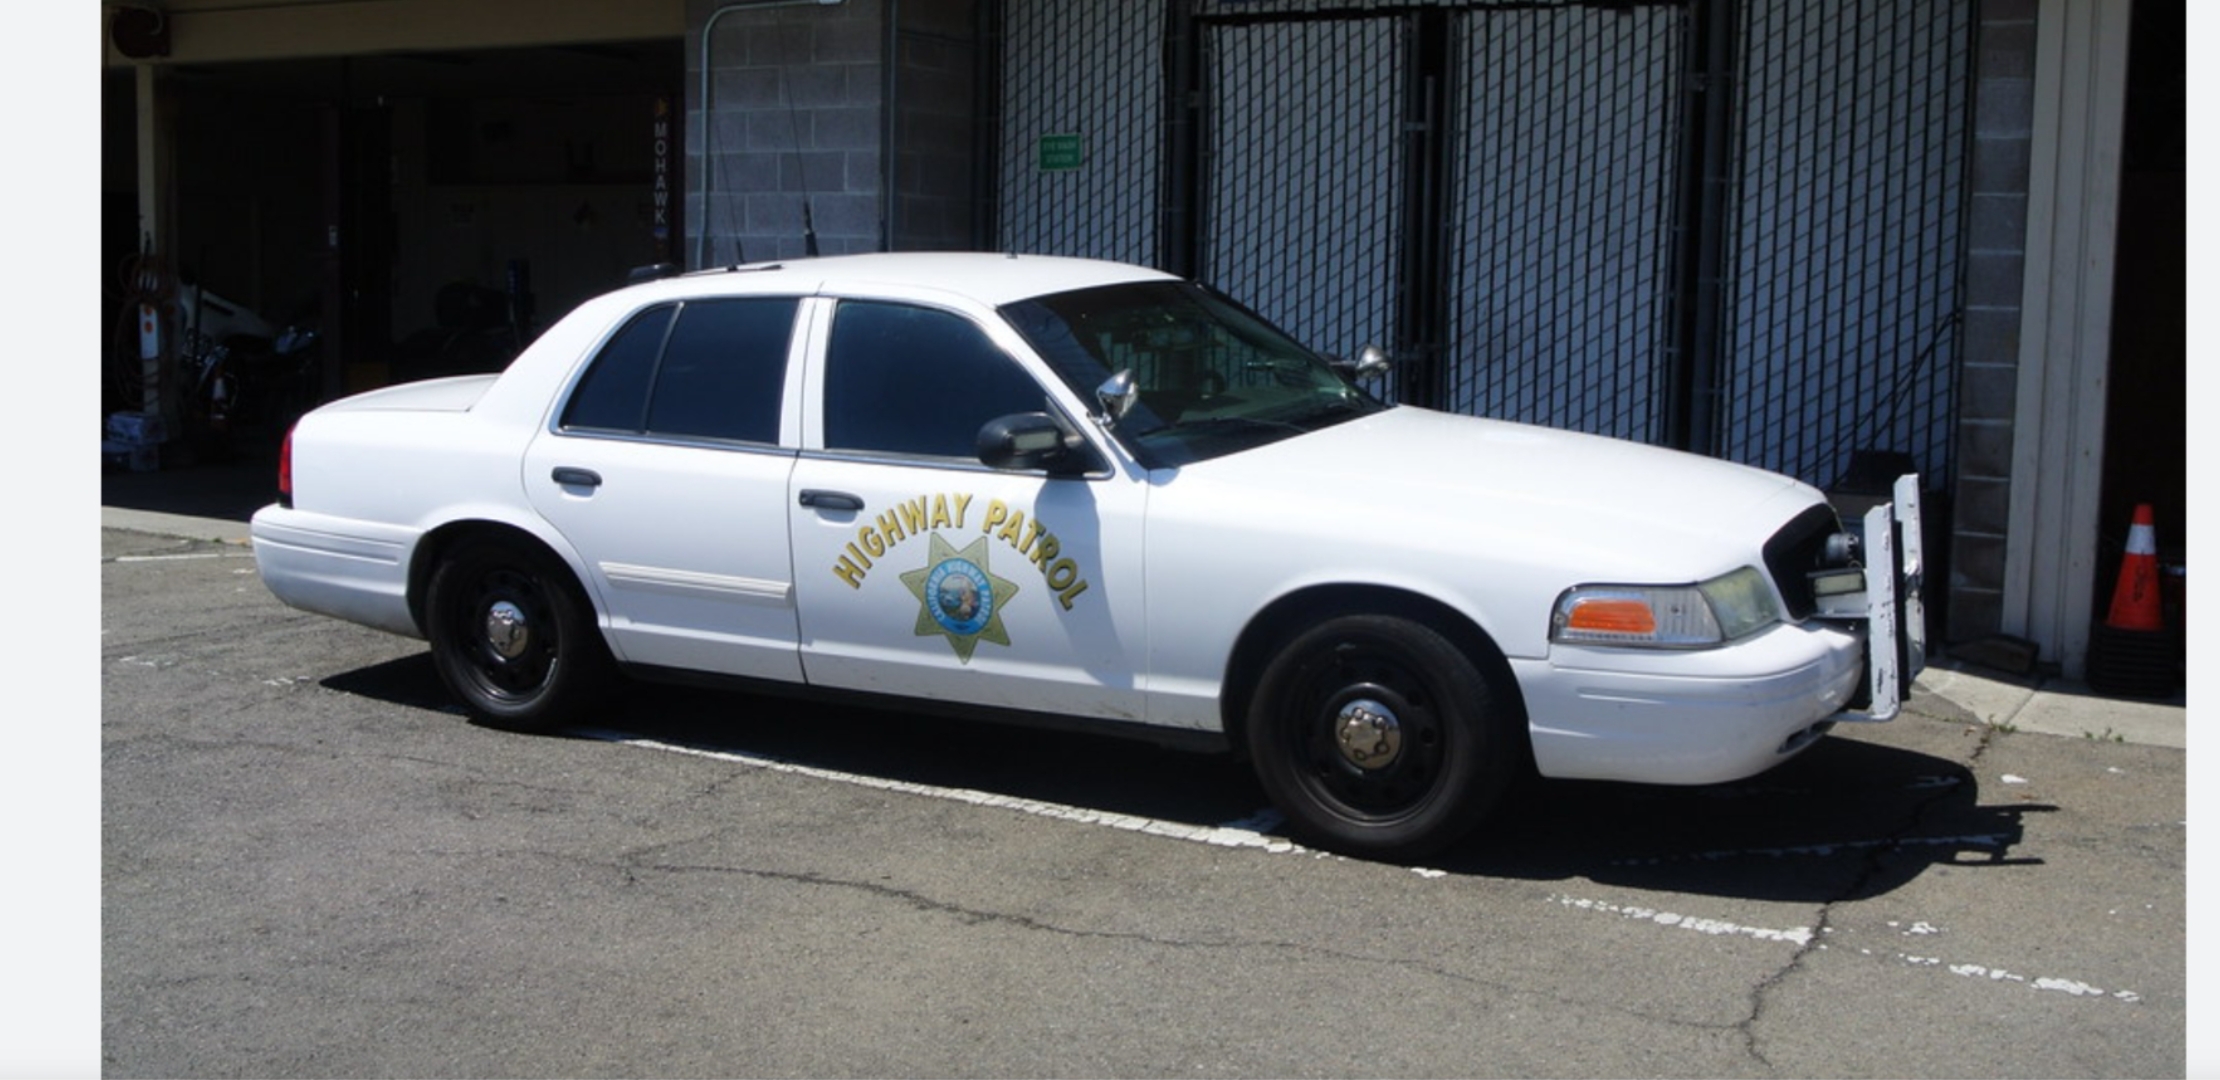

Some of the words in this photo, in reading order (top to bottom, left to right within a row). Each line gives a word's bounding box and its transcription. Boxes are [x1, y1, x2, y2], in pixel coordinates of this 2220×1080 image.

[654, 122, 668, 224] MOHAWK
[832, 493, 973, 590] HIGHWAY
[982, 499, 1089, 612] PATROL
